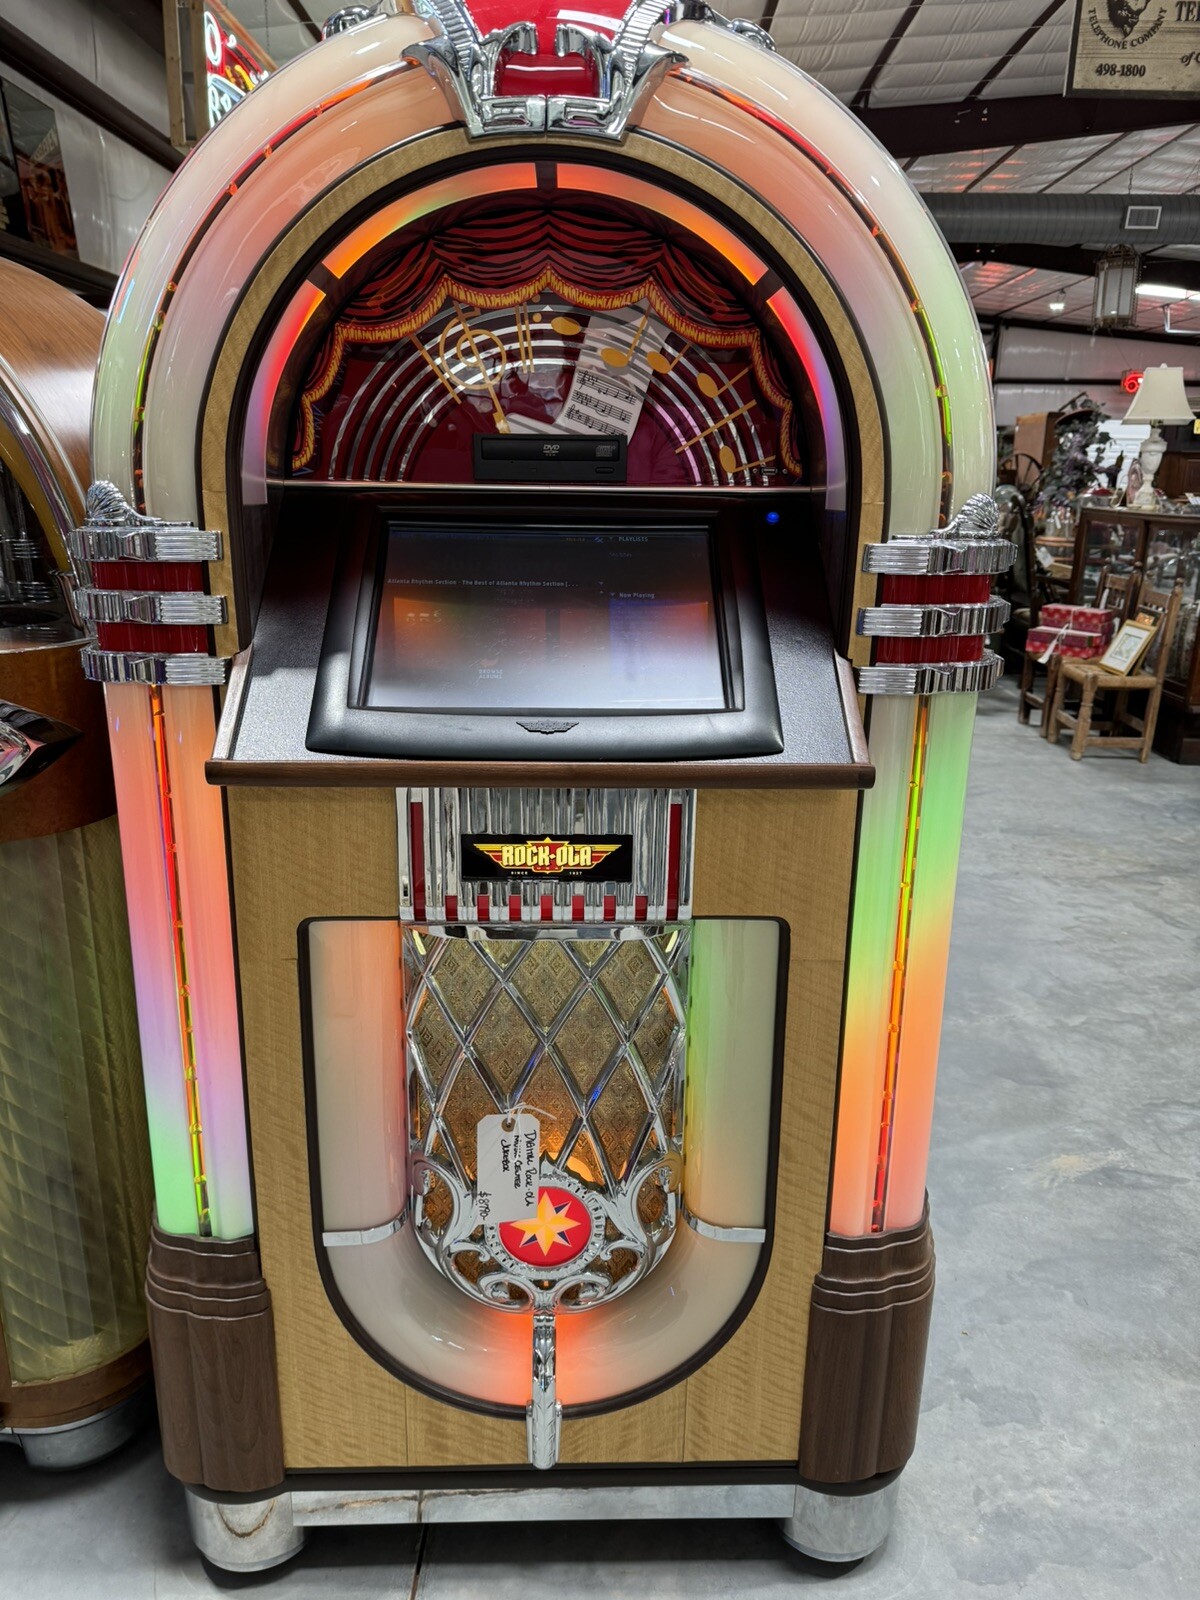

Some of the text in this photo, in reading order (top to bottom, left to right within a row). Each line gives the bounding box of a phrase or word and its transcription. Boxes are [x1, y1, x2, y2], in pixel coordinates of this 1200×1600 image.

[1175, 0, 1200, 22] TE
[1088, 7, 1167, 50] TELEPHONE COMPANY
[1180, 51, 1195, 67] of
[1095, 63, 1147, 77] 498-1800
[543, 442, 560, 450] DVD
